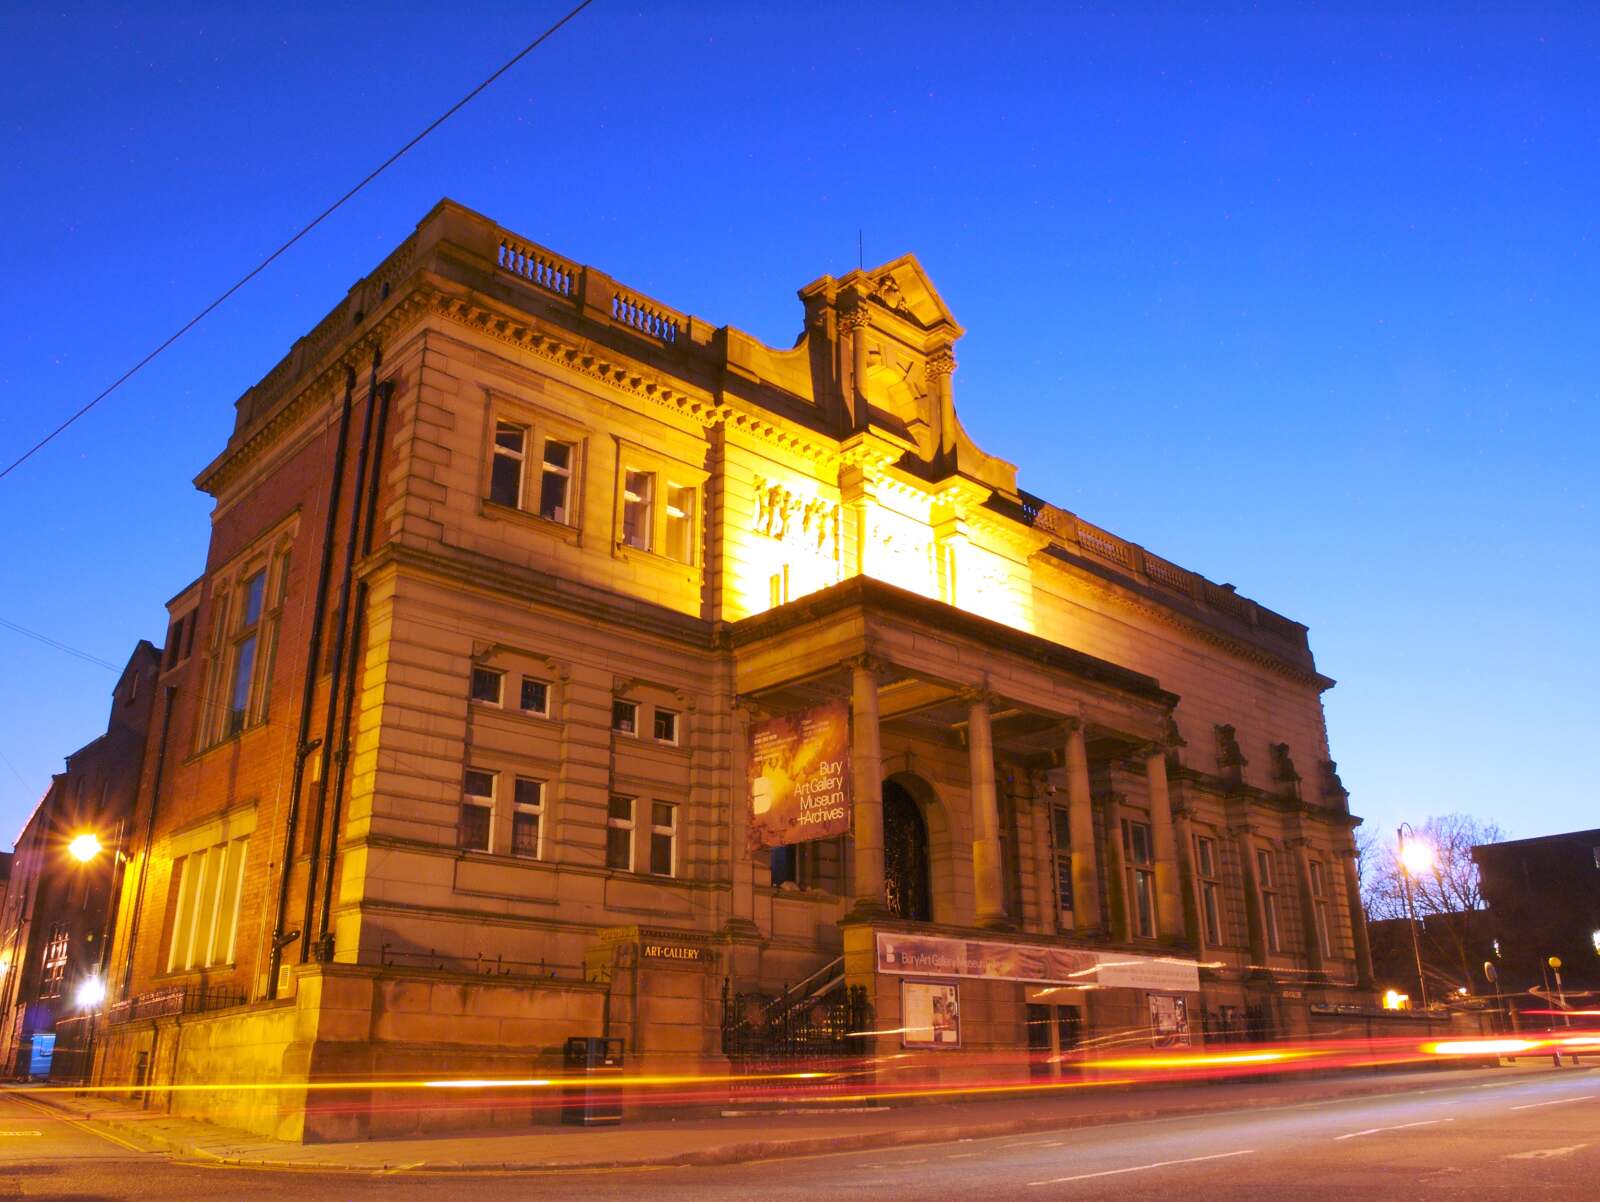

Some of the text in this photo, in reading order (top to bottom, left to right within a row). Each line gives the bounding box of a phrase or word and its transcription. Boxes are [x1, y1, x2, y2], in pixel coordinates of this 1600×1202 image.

[820, 761, 842, 775] Bury
[794, 776, 842, 796] Art Gallery
[800, 791, 844, 810] Museum
